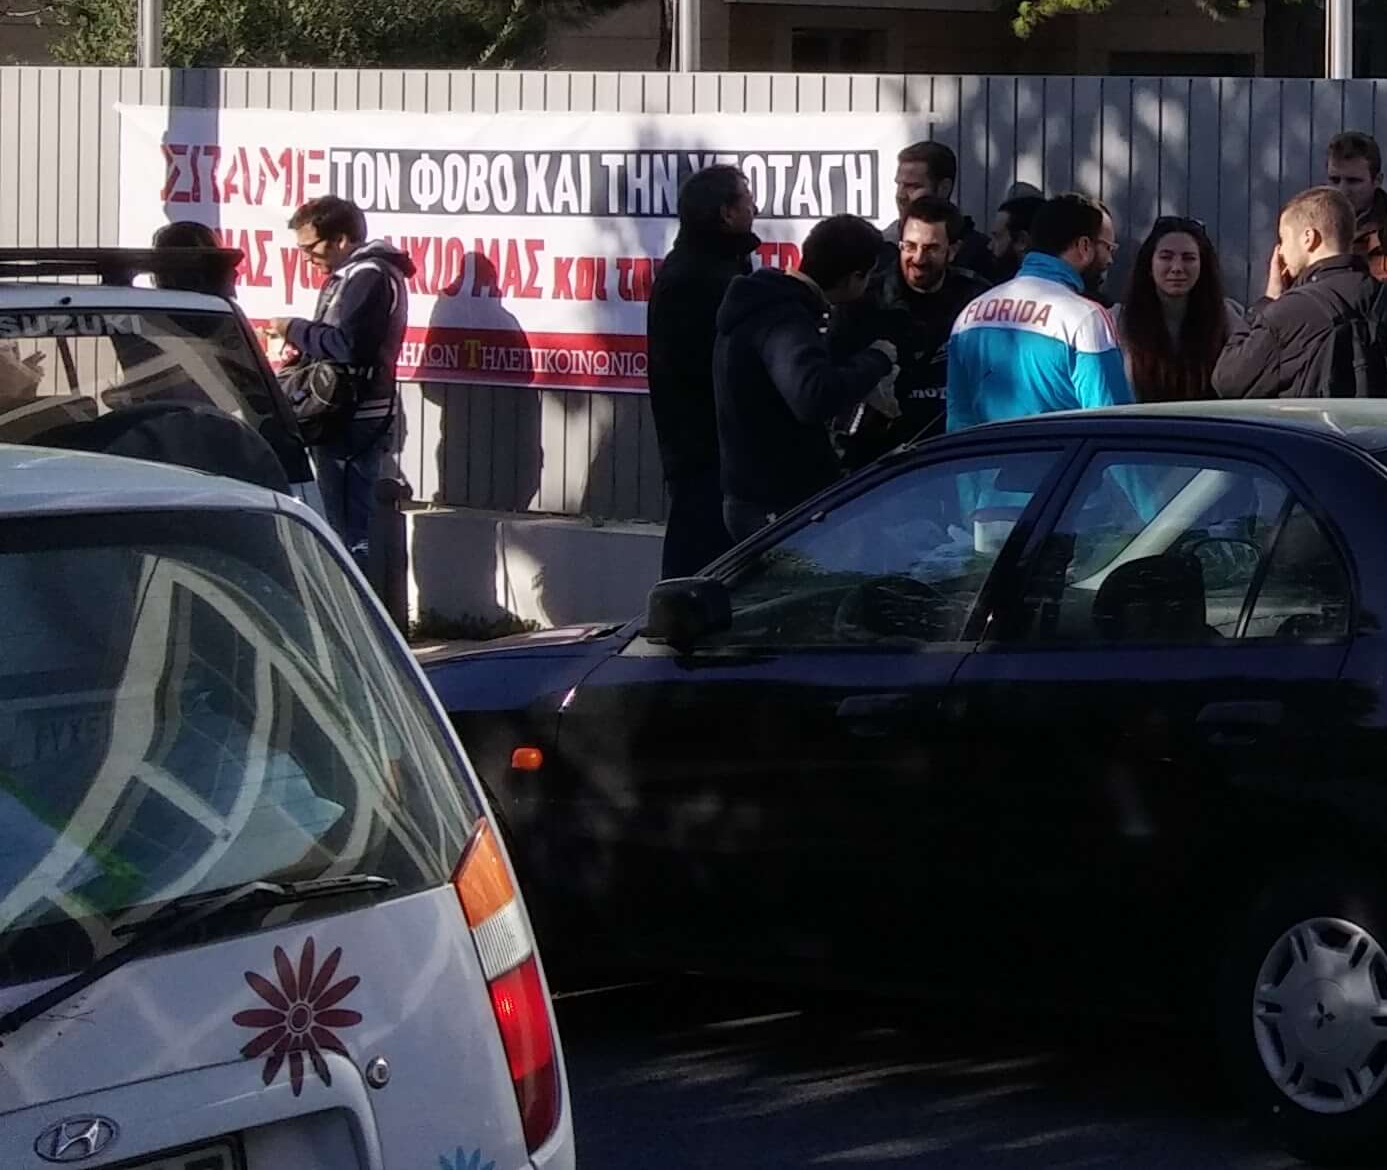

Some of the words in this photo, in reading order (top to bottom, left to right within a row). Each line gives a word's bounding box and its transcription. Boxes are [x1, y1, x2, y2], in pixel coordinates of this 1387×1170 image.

[331, 150, 400, 212] ΤΟΝ
[410, 152, 518, 215] ΦΟΒΟ
[526, 152, 592, 216] ΚΑΙ
[600, 153, 679, 216] ΤΗΝ
[688, 153, 872, 218] ΟΤΑΓΗ
[471, 237, 545, 299] ΜΑΣ
[551, 256, 608, 301] και
[0, 314, 143, 336] SUZUKI
[963, 297, 1053, 327] FLORIDA
[463, 339, 648, 377] ΤΗΛΕΠΙΚΟΙΝΩΝΙΩ
